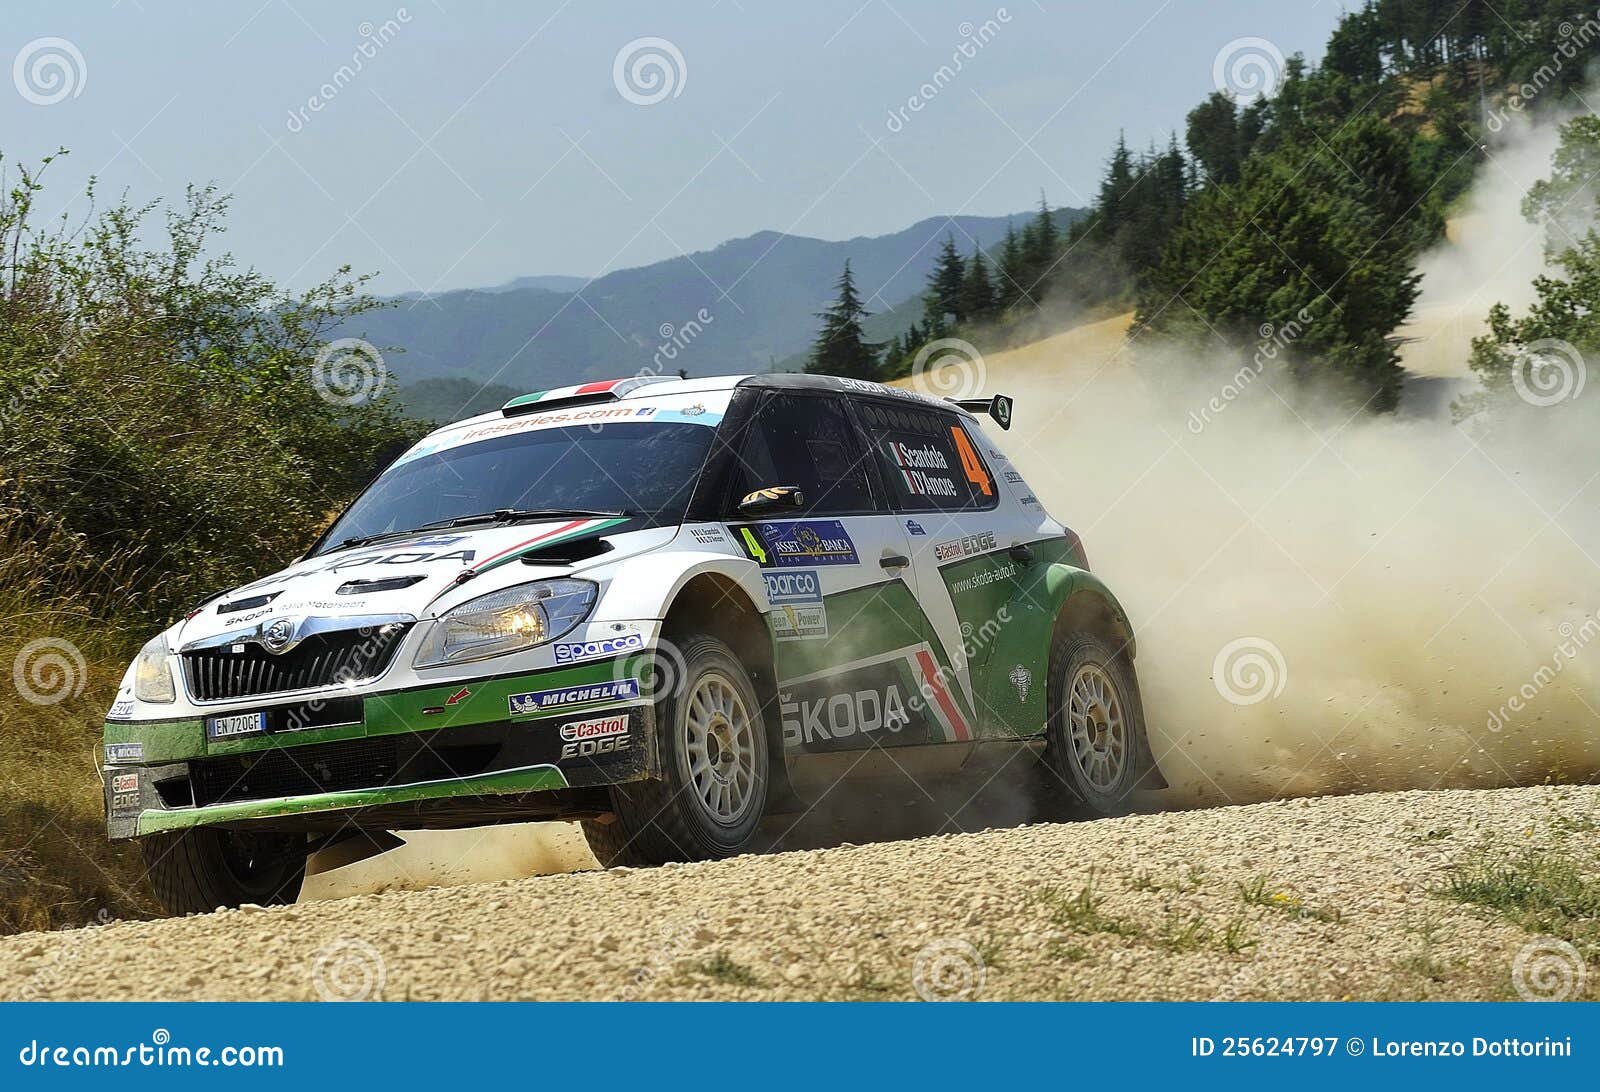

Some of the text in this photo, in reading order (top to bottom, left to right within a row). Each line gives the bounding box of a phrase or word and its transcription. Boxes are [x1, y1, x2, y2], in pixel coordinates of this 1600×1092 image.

[462, 408, 632, 441] ircseries.com
[899, 442, 948, 469] Scandola
[951, 426, 993, 496] 4
[911, 469, 957, 496] D'Amore
[740, 527, 767, 563] 4
[775, 539, 852, 553] ASSET BANCA
[940, 531, 997, 559] Castrol EDGE
[952, 561, 1017, 594] www.skoda-auto.it
[555, 636, 641, 661] sparco
[542, 683, 632, 706] MICHELIN
[216, 714, 259, 734] EN 720GF
[577, 718, 625, 738] Castrol
[561, 735, 631, 760] EDGE
[113, 793, 140, 809] EDGE
